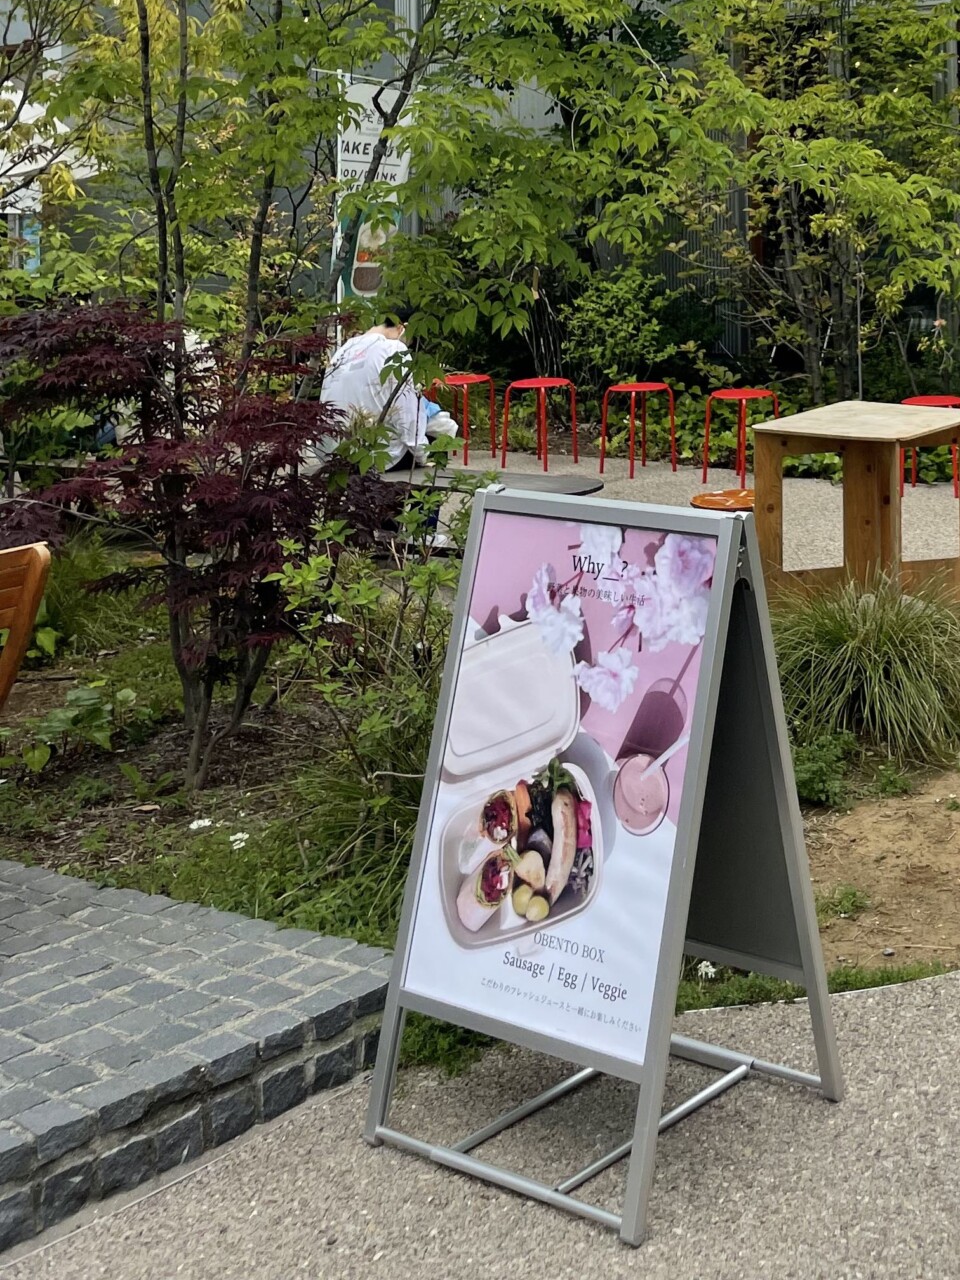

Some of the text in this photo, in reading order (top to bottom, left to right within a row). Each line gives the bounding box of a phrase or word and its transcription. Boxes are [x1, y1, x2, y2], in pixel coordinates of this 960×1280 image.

[533, 931, 606, 964] OBENTO BOX
[502, 951, 546, 978] Sausage
[557, 966, 578, 990] Egg
[591, 976, 628, 1002] Veggie
